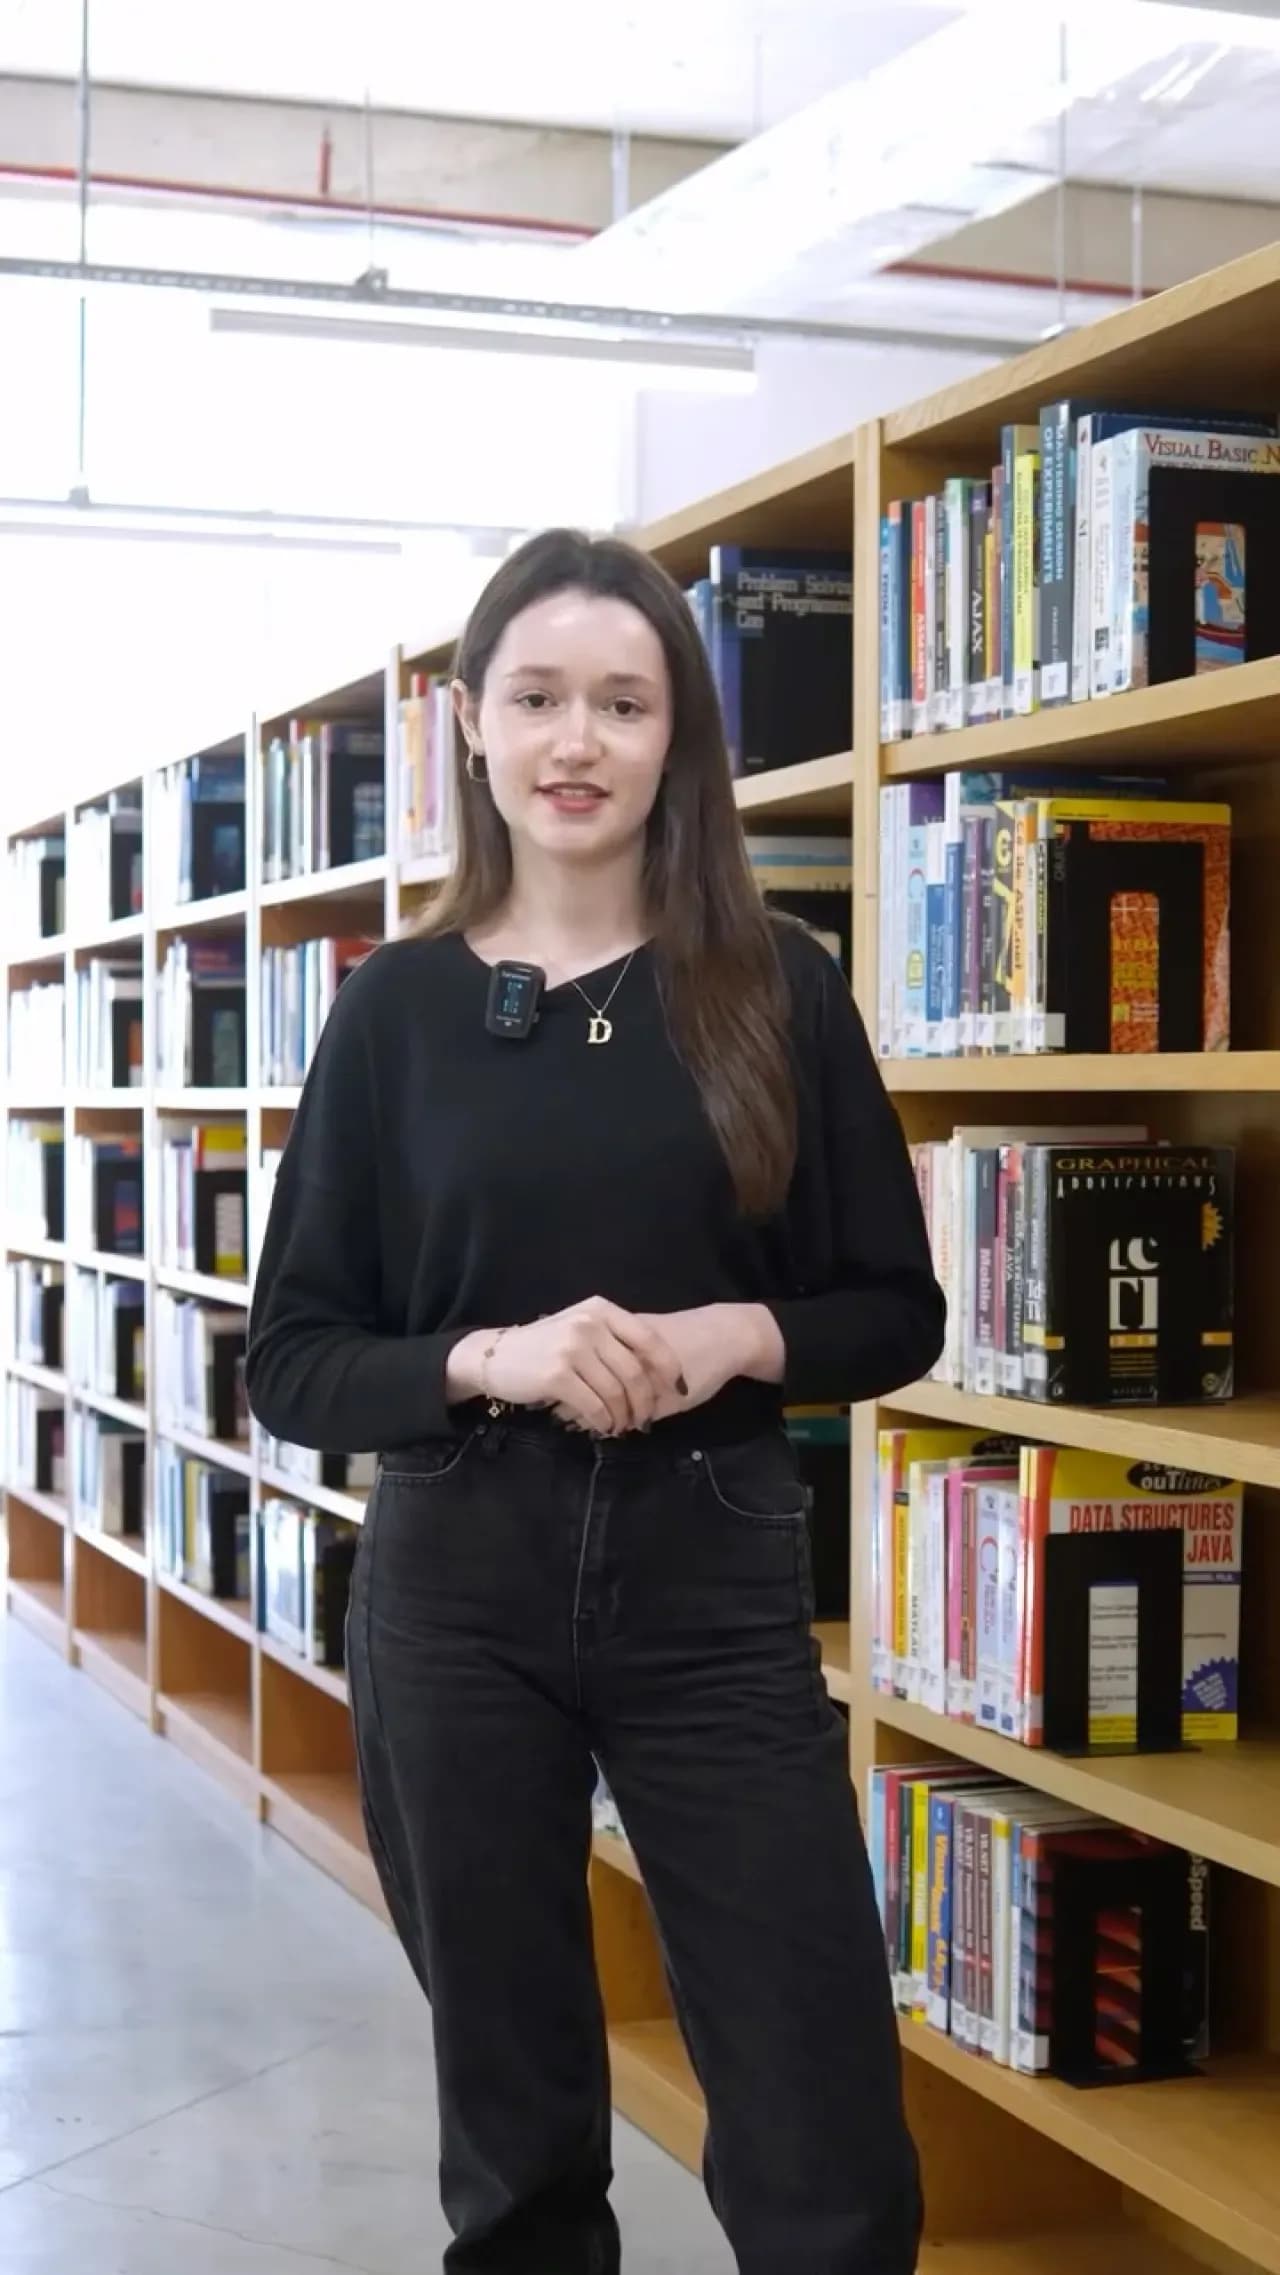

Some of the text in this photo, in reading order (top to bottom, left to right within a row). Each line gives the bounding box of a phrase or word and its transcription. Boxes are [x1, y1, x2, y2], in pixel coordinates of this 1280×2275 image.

[1207, 438, 1258, 463] BASIC
[1042, 427, 1053, 584] OF EXPERIMENTS
[1055, 523, 1064, 581] DESIGN
[972, 590, 984, 655] AJAX
[587, 1018, 613, 1044] D
[1056, 1156, 1216, 1170] GRAPHICAL
[978, 1248, 992, 1311] Mobile
[1069, 1502, 1235, 1532] DATA STRUCTURES
[1186, 1534, 1234, 1563] JAVA
